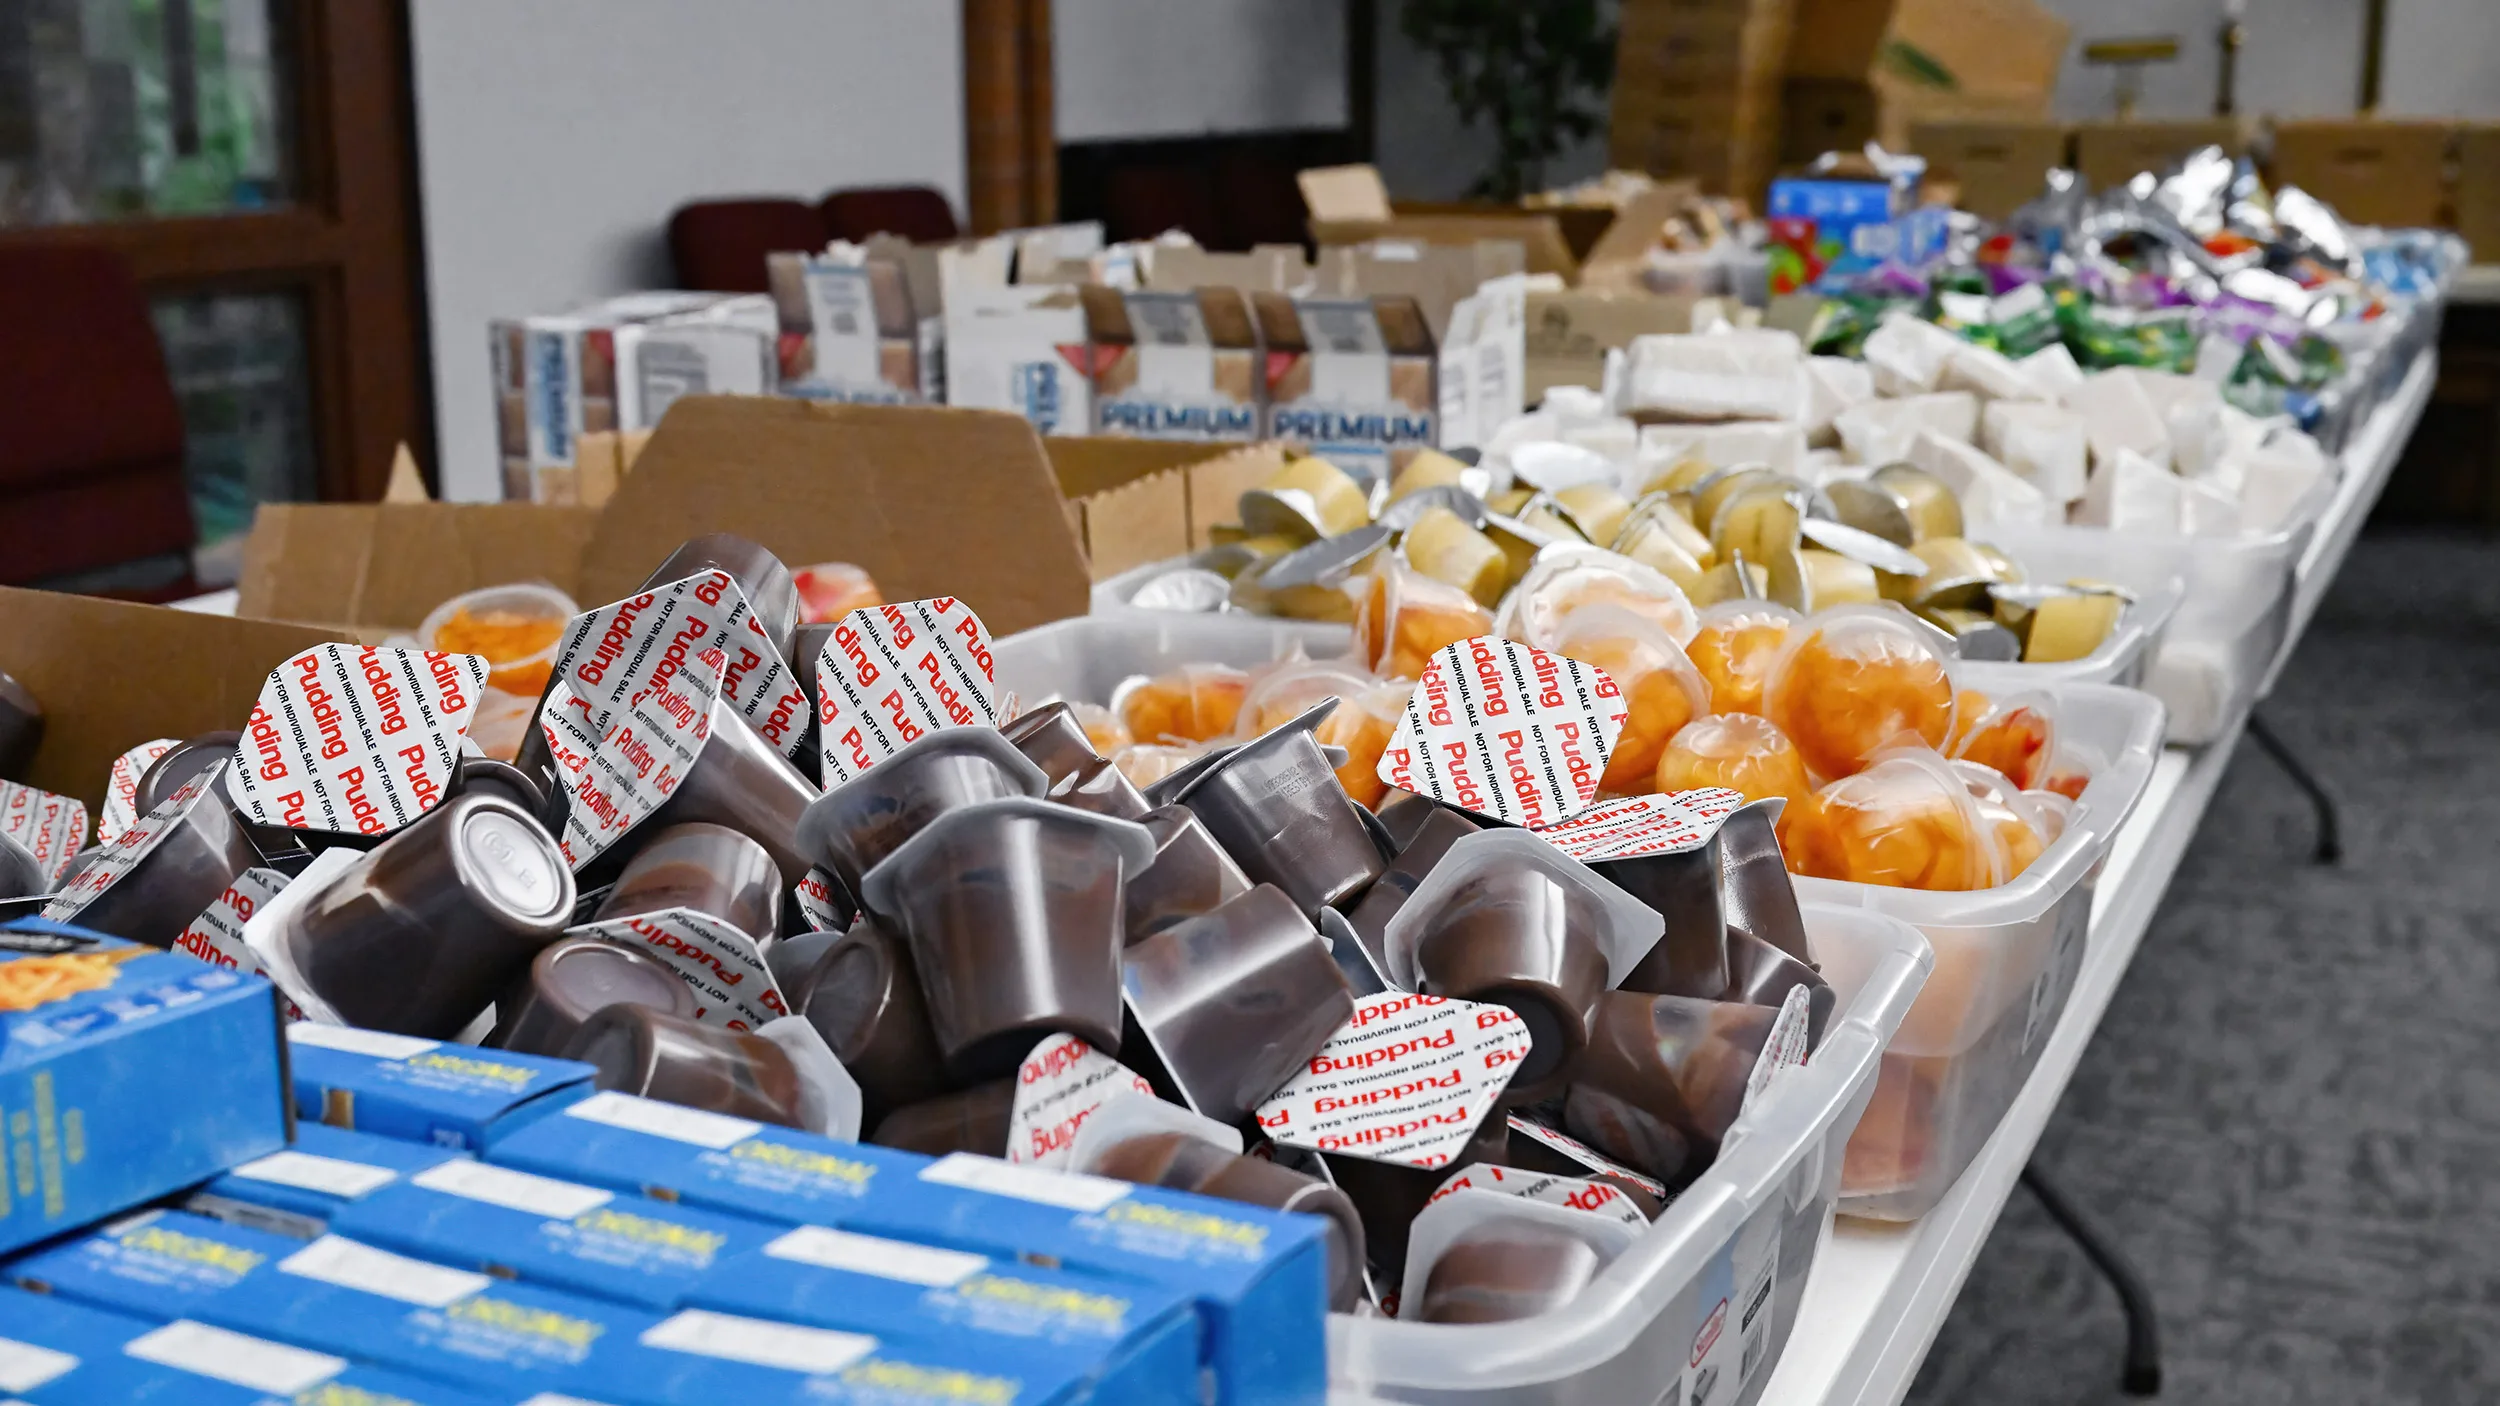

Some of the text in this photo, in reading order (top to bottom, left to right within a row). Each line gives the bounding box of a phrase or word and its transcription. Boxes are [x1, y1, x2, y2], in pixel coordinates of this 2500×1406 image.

[1102, 401, 1250, 436] PREMIUM
[1273, 409, 1431, 444] PREMIUM
[650, 617, 666, 635] FOR
[662, 598, 676, 618] NOT
[714, 602, 746, 649] SALE NOT
[578, 594, 654, 685] Pudding
[624, 635, 655, 677] INDIVIDUAL
[835, 626, 880, 687] ding
[466, 652, 483, 683] VIDUAL
[556, 651, 575, 674] SALE
[855, 610, 881, 646] IVIDUAL
[881, 645, 900, 669] SALE
[901, 672, 916, 691] NOT
[914, 691, 928, 711] FOR
[919, 608, 936, 632] SALE
[935, 634, 950, 653] NOT
[947, 653, 962, 673] FOR
[960, 672, 997, 720] INDIVIDUAL
[1467, 636, 1509, 716] udding
[424, 646, 467, 714] dding
[611, 680, 629, 703] SALE
[754, 662, 781, 699] NOT FOR
[918, 652, 974, 725] Puddi
[401, 659, 425, 705] INDIVIDUAL
[421, 705, 436, 728] SALE
[433, 733, 446, 750] NOT
[441, 751, 455, 770] FOR
[652, 677, 696, 729] Pudding
[816, 649, 844, 684] VIDUAL
[843, 683, 861, 708] SALE
[861, 710, 877, 729] NOT
[874, 729, 889, 749] FOR
[327, 645, 410, 827] NOT FOR INDIVIDUAL SALE NOT FOR INDIVID
[548, 708, 587, 743] NOT FOR
[597, 710, 611, 729] NOT
[1505, 647, 1566, 813] INDIVIDUAL SALE NOT FOR INDIVIDUAL
[1577, 688, 1591, 710] SALE
[1587, 716, 1600, 733] NOT
[1594, 735, 1605, 753] FOR
[248, 701, 288, 781] dding
[276, 684, 289, 703] FOR
[283, 704, 308, 753] INDIVIDUAL
[303, 753, 317, 775] SALE
[313, 779, 327, 798] NOT
[321, 799, 333, 816] FOR
[292, 654, 348, 760] Pudding
[338, 766, 387, 835] Puddi
[1410, 713, 1423, 735] SALE
[1419, 741, 1430, 760] NOT
[1425, 762, 1436, 779] FOR
[1450, 655, 1470, 703] INDIVIDUAL
[1466, 704, 1479, 727] SALE
[1475, 733, 1487, 750] NOT
[1481, 753, 1493, 772] FOR
[1487, 774, 1508, 822] INDIVIDUAL
[824, 749, 847, 782] NOT FO
[1443, 742, 1485, 811] Puddi
[240, 769, 265, 818] SALE NOT
[1673, 796, 1693, 805] NOT
[1548, 801, 1650, 833] udding
[1577, 819, 1633, 832] INDIVIDUAL
[1636, 808, 1664, 818] SALE
[247, 870, 268, 888] SALE
[625, 919, 741, 983] Puddin
[718, 941, 741, 957] FOR
[741, 956, 765, 972] NOT
[706, 987, 729, 1002] NOT
[1352, 994, 1447, 1028] Puddi
[1405, 1018, 1428, 1029] FOR
[1433, 1010, 1455, 1020] NOT
[1310, 1029, 1455, 1075] Pudding
[1332, 1025, 1401, 1046] INDIVIDUAL
[1475, 1036, 1504, 1050] SALE
[1412, 1060, 1436, 1070] FOR
[1442, 1051, 1464, 1062] NOT
[1306, 1084, 1337, 1092] SALE
[1314, 1069, 1461, 1113] Pudding
[1344, 1068, 1408, 1086] INDIVIDUAL
[1482, 1076, 1510, 1087] ALE
[1318, 1106, 1467, 1150] Pudding
